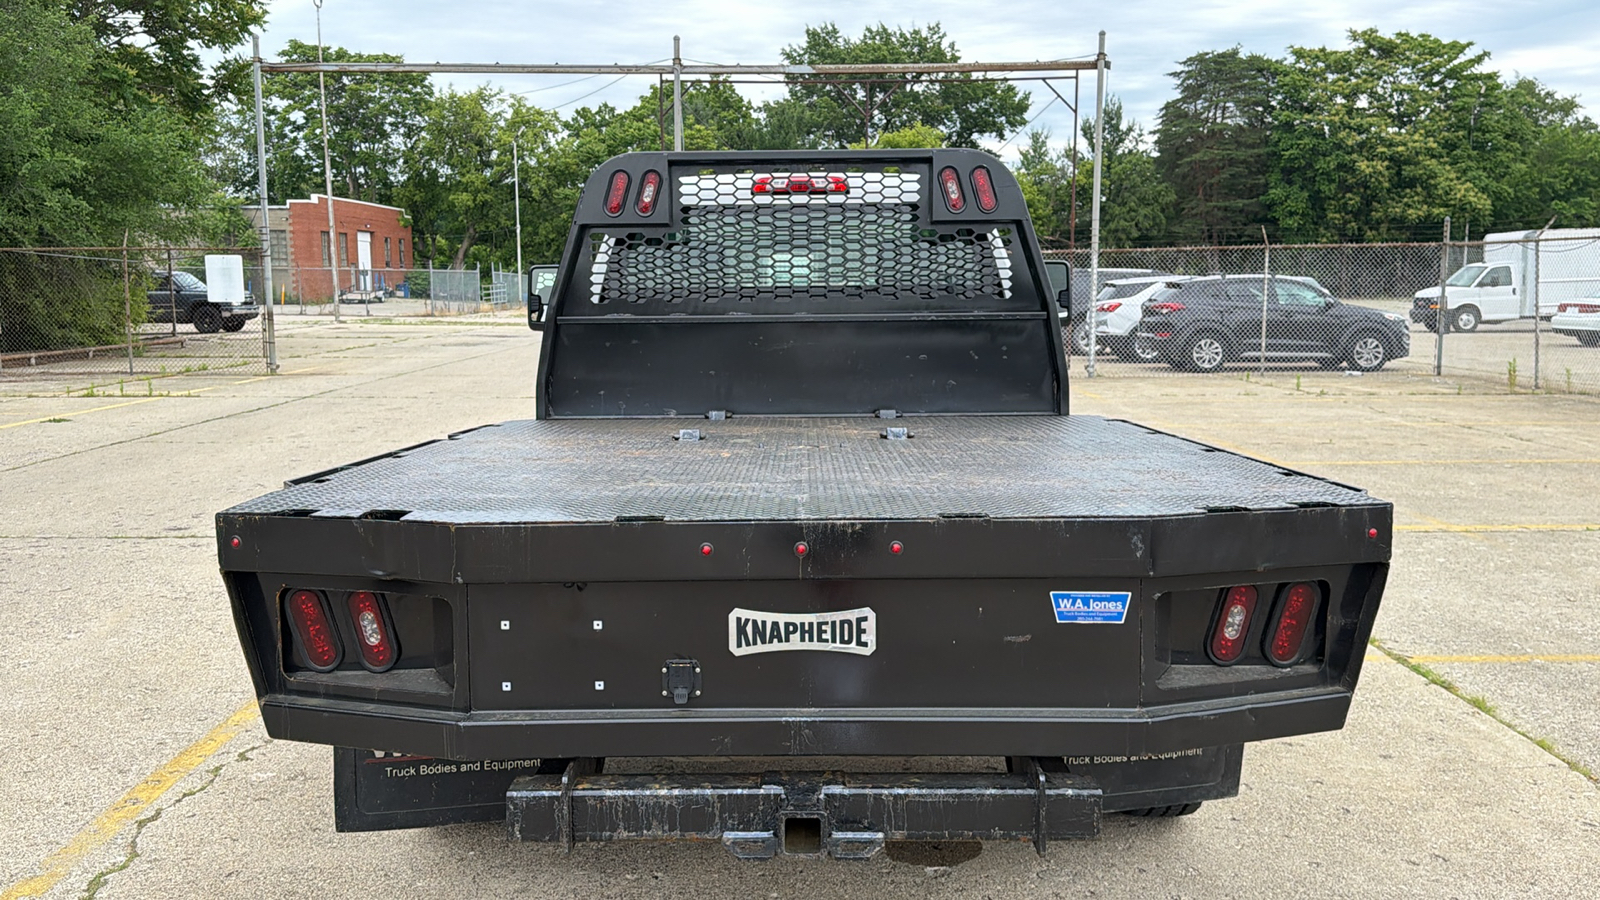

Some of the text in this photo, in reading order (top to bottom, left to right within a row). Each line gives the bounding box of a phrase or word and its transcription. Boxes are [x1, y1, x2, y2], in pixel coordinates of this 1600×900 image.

[1058, 598, 1123, 611] W.A. Jones
[735, 615, 869, 649] KNAPHEIDE
[385, 758, 541, 777] Truck Bodies and Equipment
[1062, 755, 1091, 765] Truck
